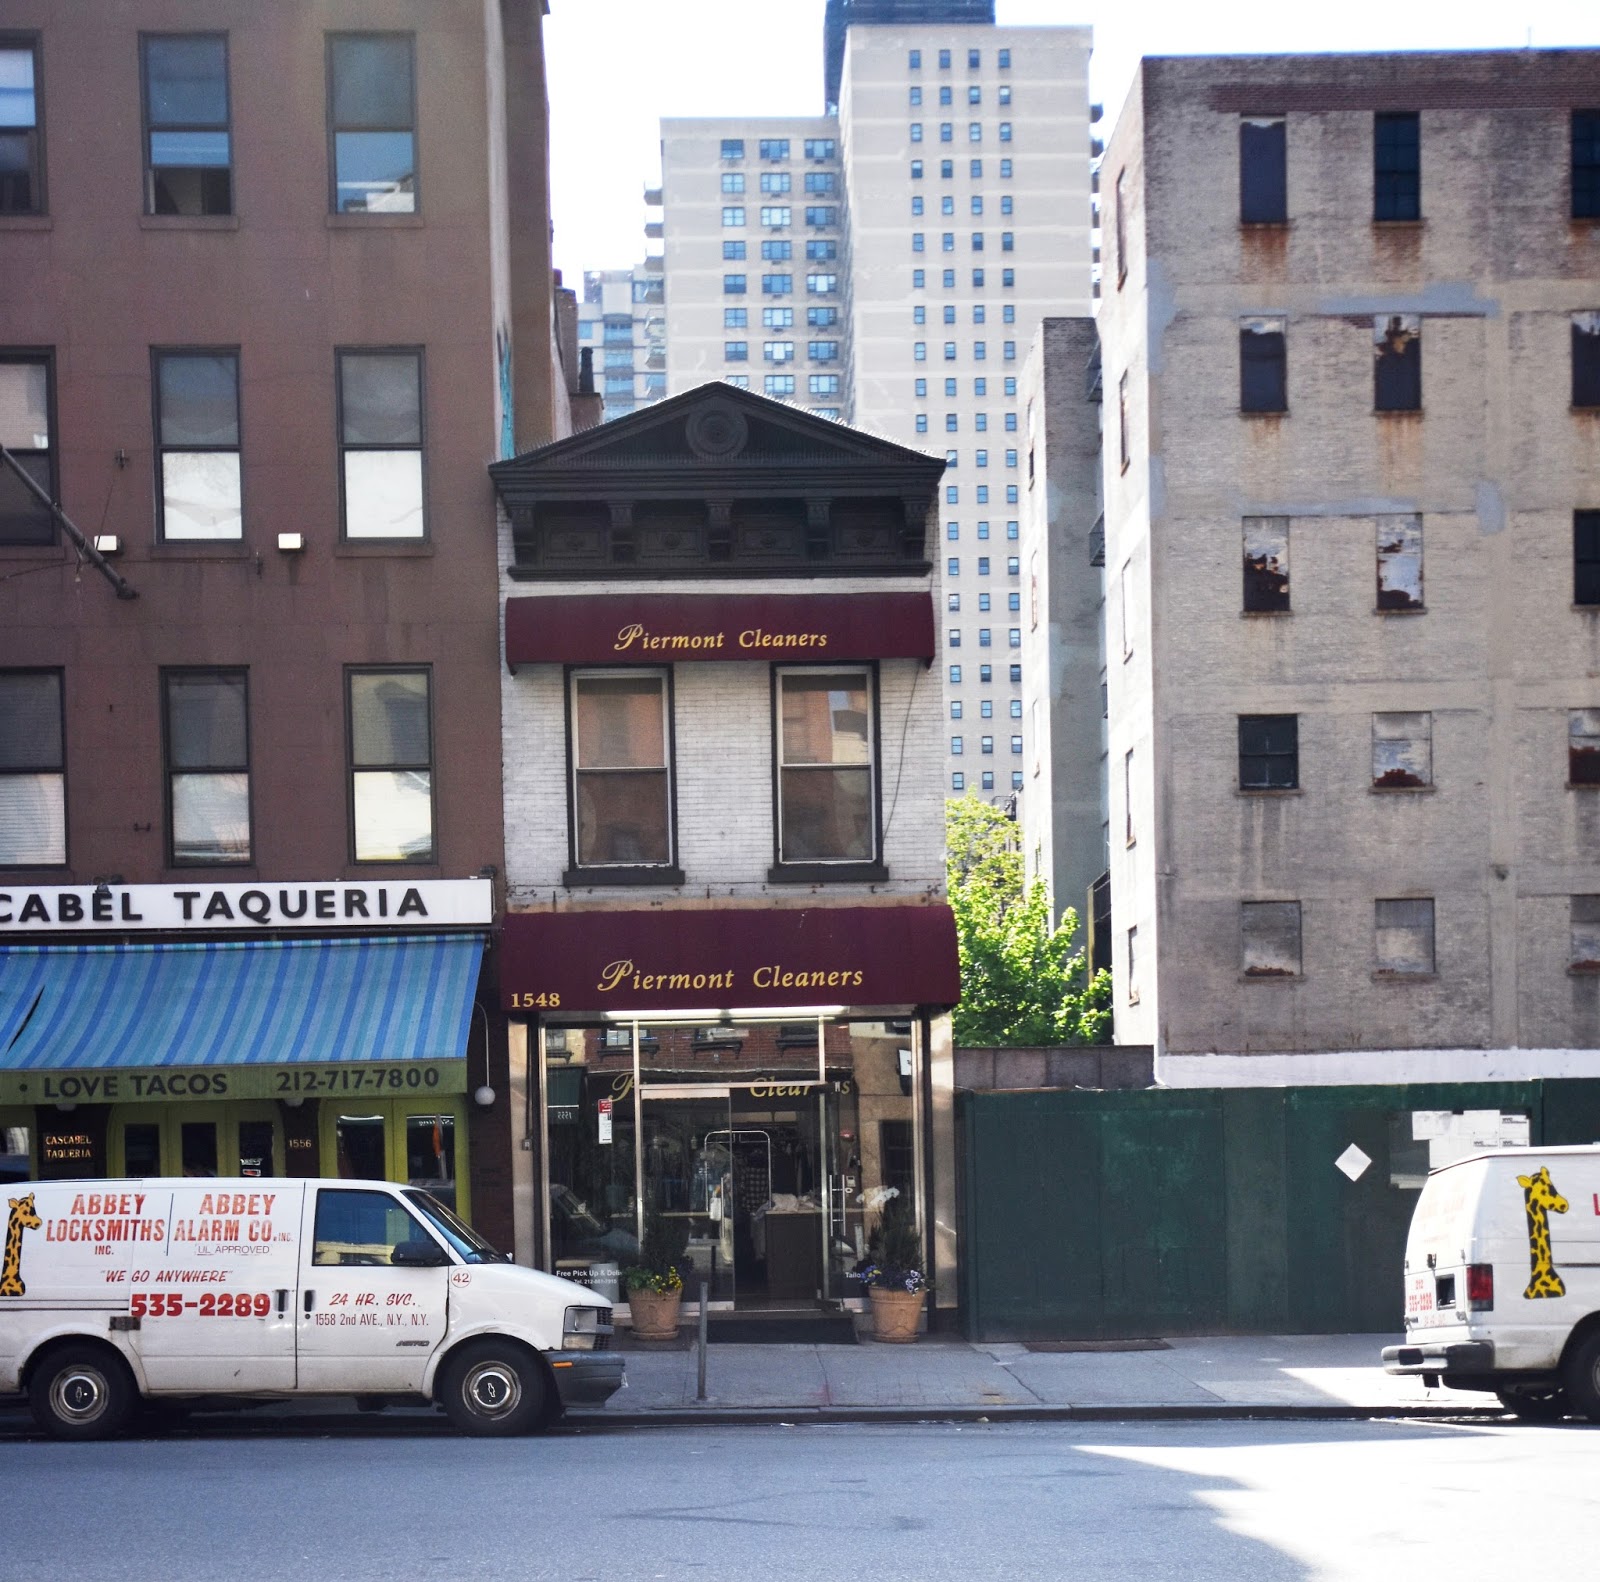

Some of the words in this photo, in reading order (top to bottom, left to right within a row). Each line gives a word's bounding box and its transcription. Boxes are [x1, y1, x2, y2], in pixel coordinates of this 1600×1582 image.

[613, 623, 725, 651] Piermont
[738, 629, 828, 648] Cleaners
[173, 887, 429, 924] TAQUERIA
[596, 959, 734, 991] Piermont
[752, 966, 864, 989] Cleaners
[510, 993, 561, 1008] 1548
[44, 1076, 118, 1098] LOVE
[130, 1073, 228, 1096] TACOS
[276, 1068, 440, 1092] 212-717-7800
[46, 1135, 92, 1145] CASCABEL
[289, 1139, 312, 1148] 1556
[47, 1149, 92, 1159] TAQUERIA
[70, 1194, 146, 1215] ABBEY
[199, 1194, 276, 1216] ABBEY
[46, 1219, 165, 1242] LOCKSMITHS
[174, 1219, 240, 1242] ALARM
[94, 1245, 115, 1255] INC.
[215, 1245, 270, 1254] APPROVED
[131, 1270, 150, 1283] GO
[453, 1272, 470, 1283] 42
[588, 1269, 599, 1277] Up
[131, 1293, 271, 1317] 535-2289
[328, 1293, 349, 1306] 24
[355, 1293, 379, 1306] HR.
[386, 1293, 416, 1306] SVC.
[315, 1313, 336, 1326] 1558
[340, 1313, 356, 1326] 2nd
[411, 1313, 429, 1326] N.Y.
